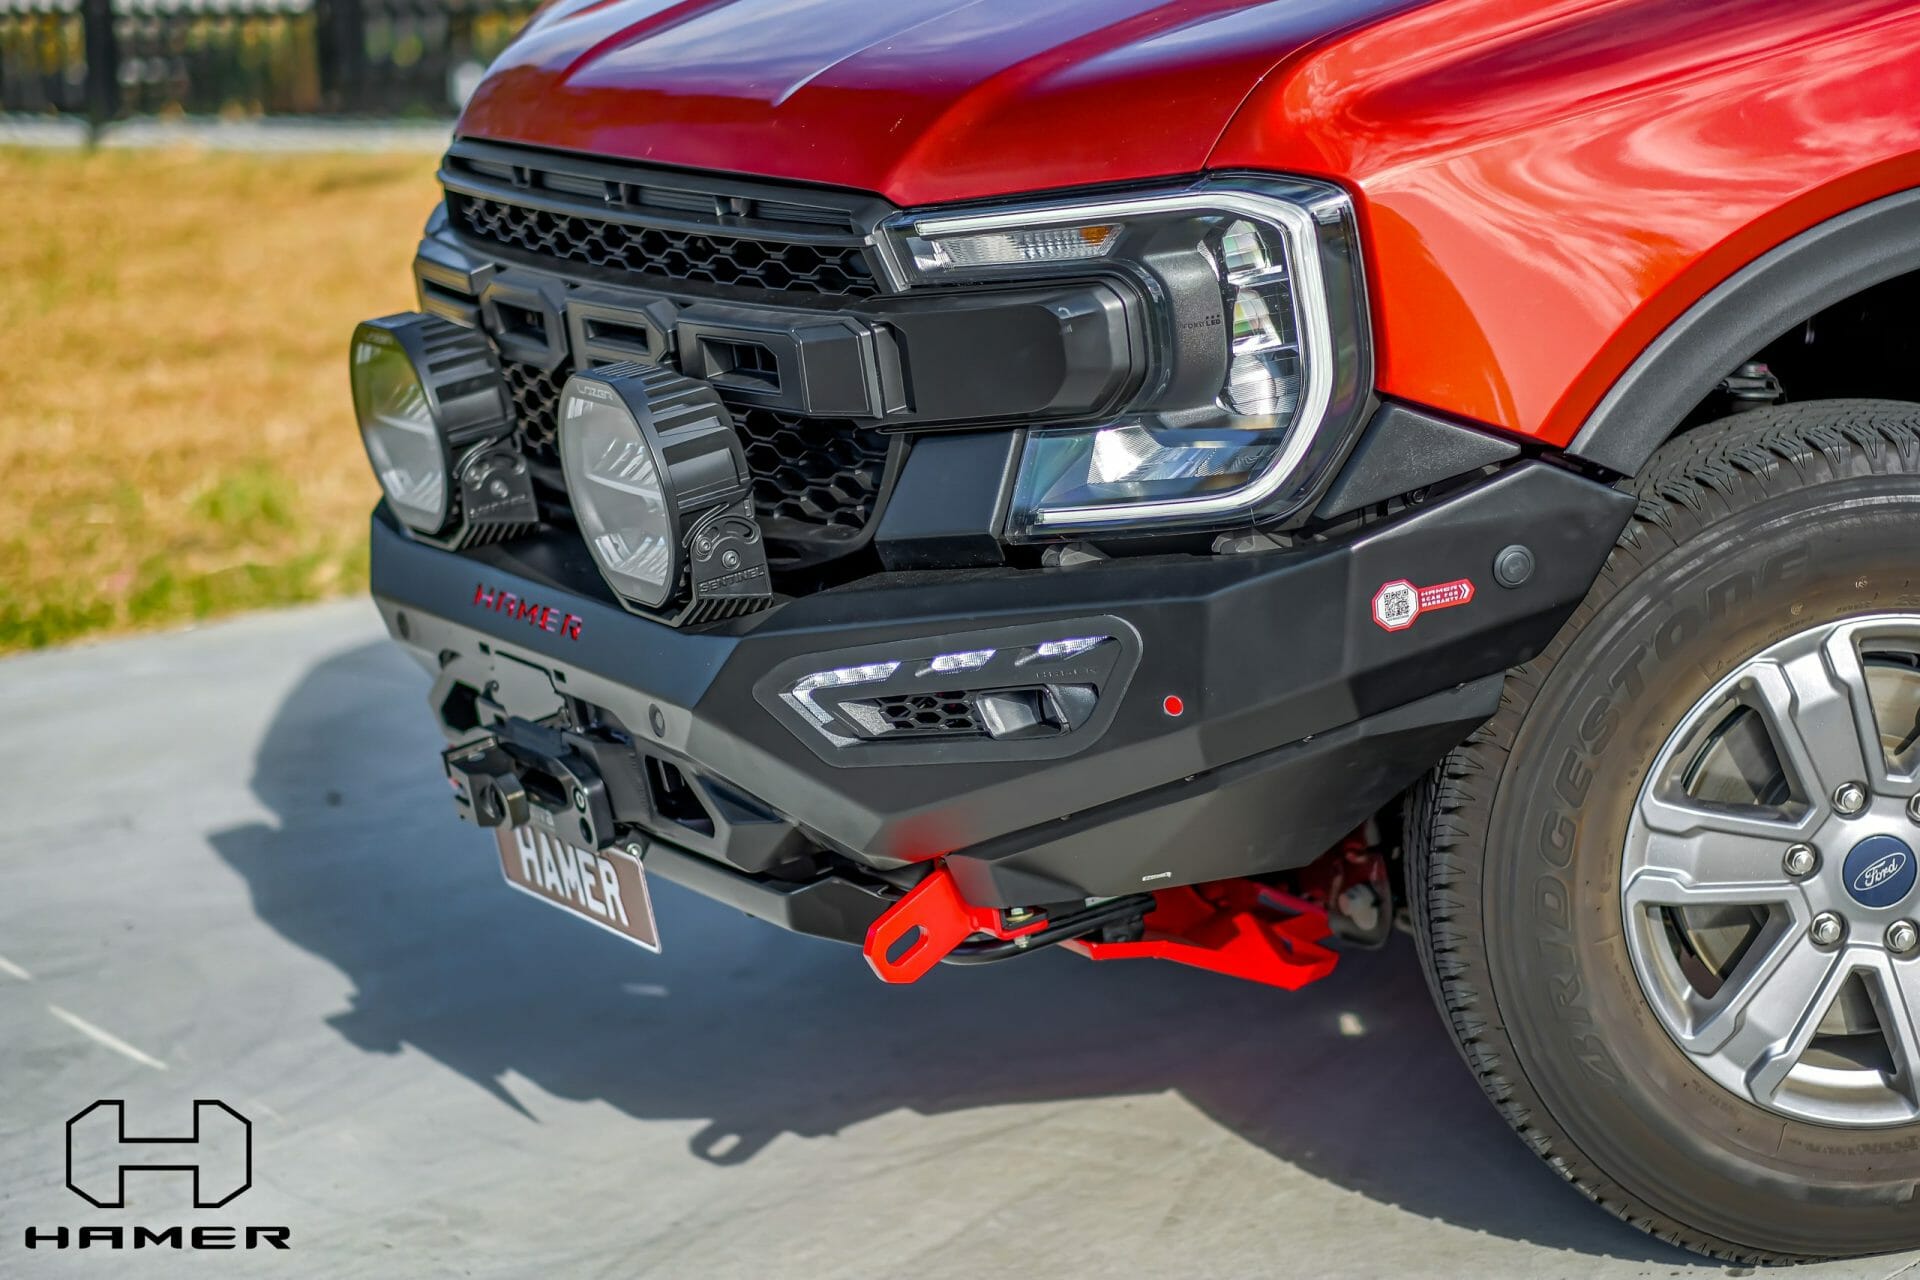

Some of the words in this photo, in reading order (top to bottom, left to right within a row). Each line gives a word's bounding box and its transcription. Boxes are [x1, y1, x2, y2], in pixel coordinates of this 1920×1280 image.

[699, 567, 765, 592] SENTINEL
[1421, 594, 1441, 602] SCAN
[1421, 597, 1459, 608] WARRANTY
[473, 583, 583, 641] HAMER
[514, 827, 629, 927] HAMER
[1864, 858, 1899, 887] Ford
